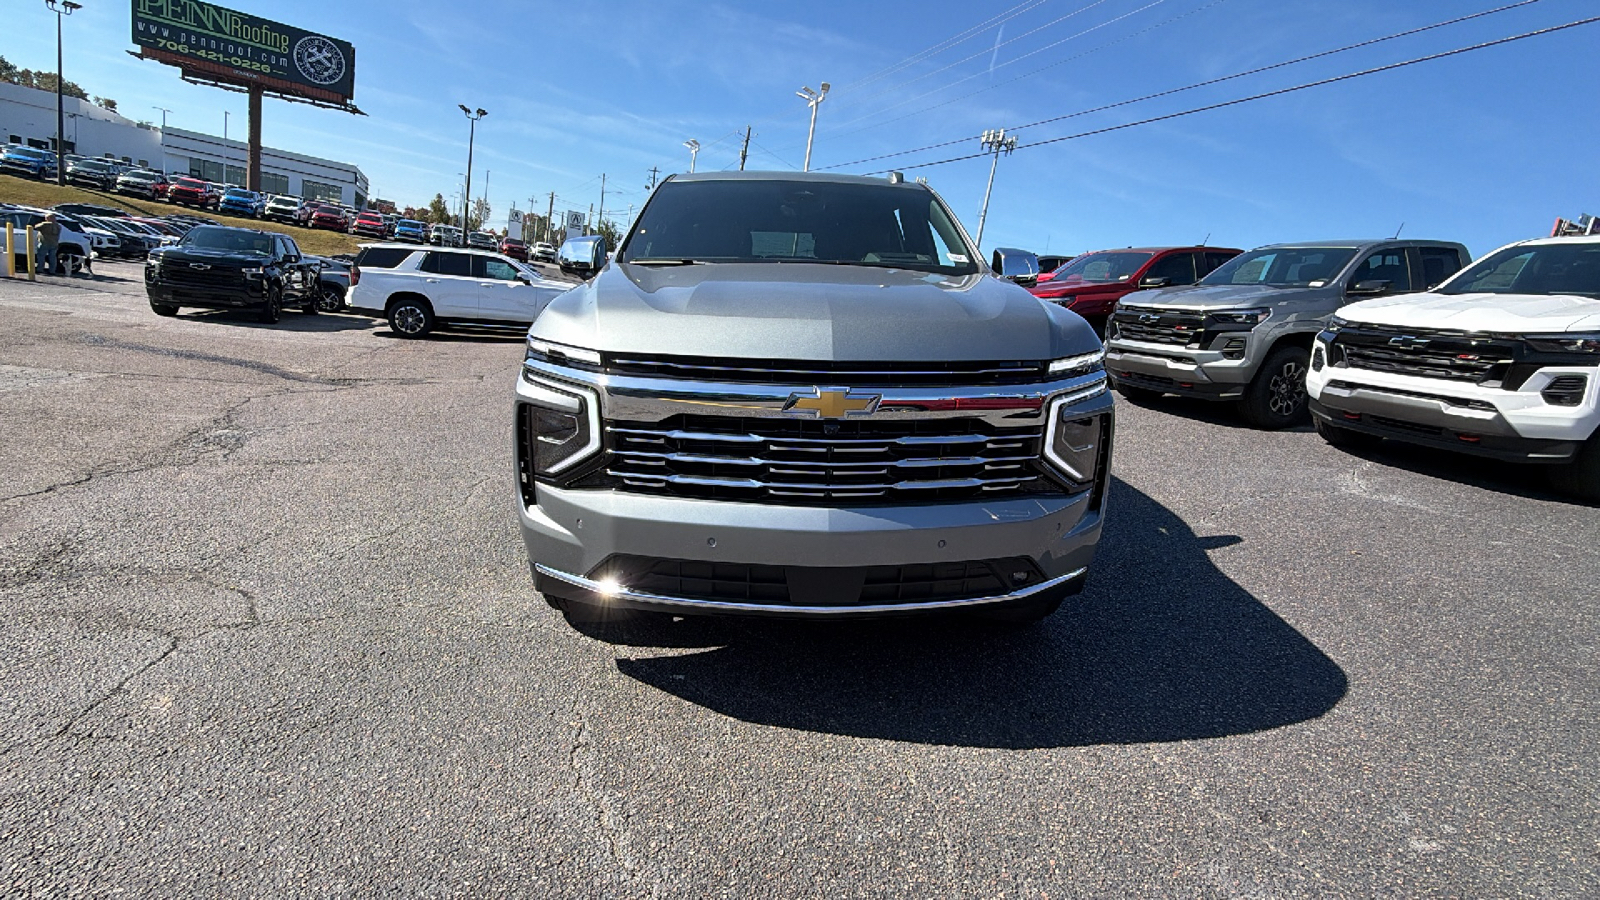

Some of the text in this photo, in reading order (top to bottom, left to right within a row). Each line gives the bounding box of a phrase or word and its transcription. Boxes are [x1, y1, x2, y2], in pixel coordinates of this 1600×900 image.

[137, 21, 288, 67] www.pennroof.com
[231, 16, 289, 54] Roofing
[156, 38, 271, 73] 706-421-0226
